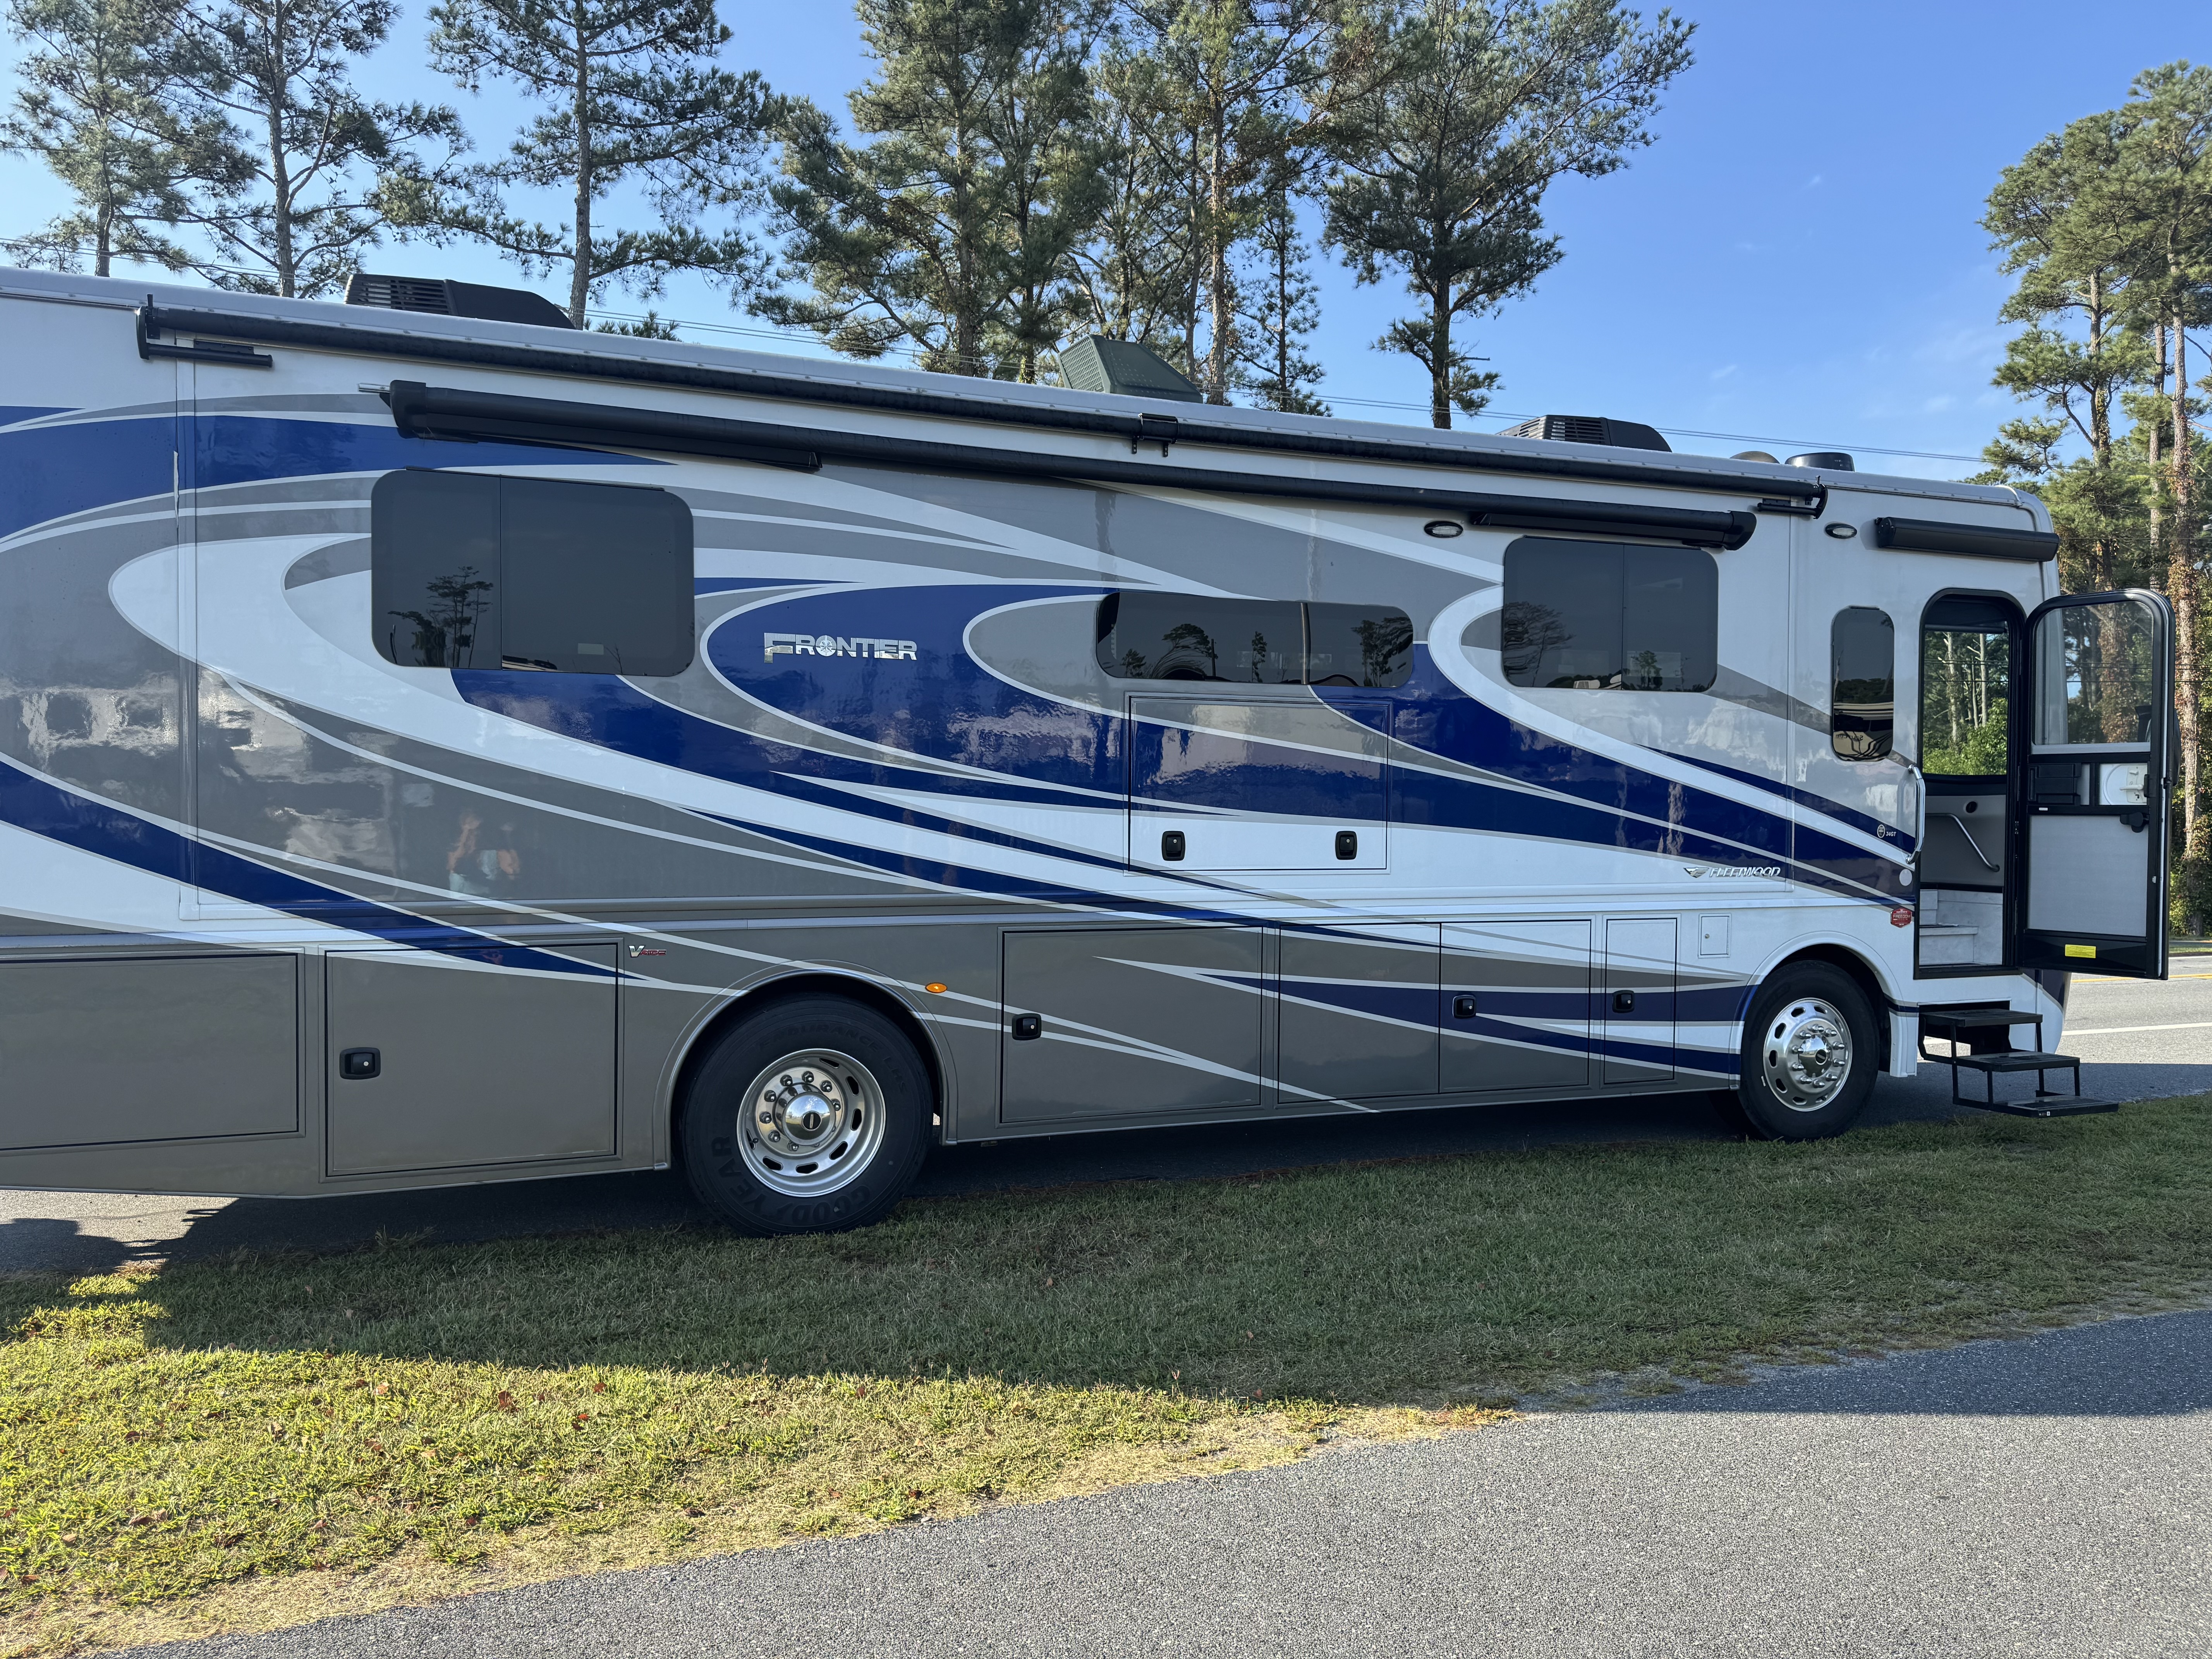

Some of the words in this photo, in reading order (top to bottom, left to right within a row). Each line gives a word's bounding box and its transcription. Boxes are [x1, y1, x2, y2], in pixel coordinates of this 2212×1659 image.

[764, 632, 917, 663] FRONTIER
[1709, 866, 1781, 878] FLEETWOOD
[759, 1024, 885, 1052] ENDURANCE
[711, 1135, 871, 1224] GOODYEAR
